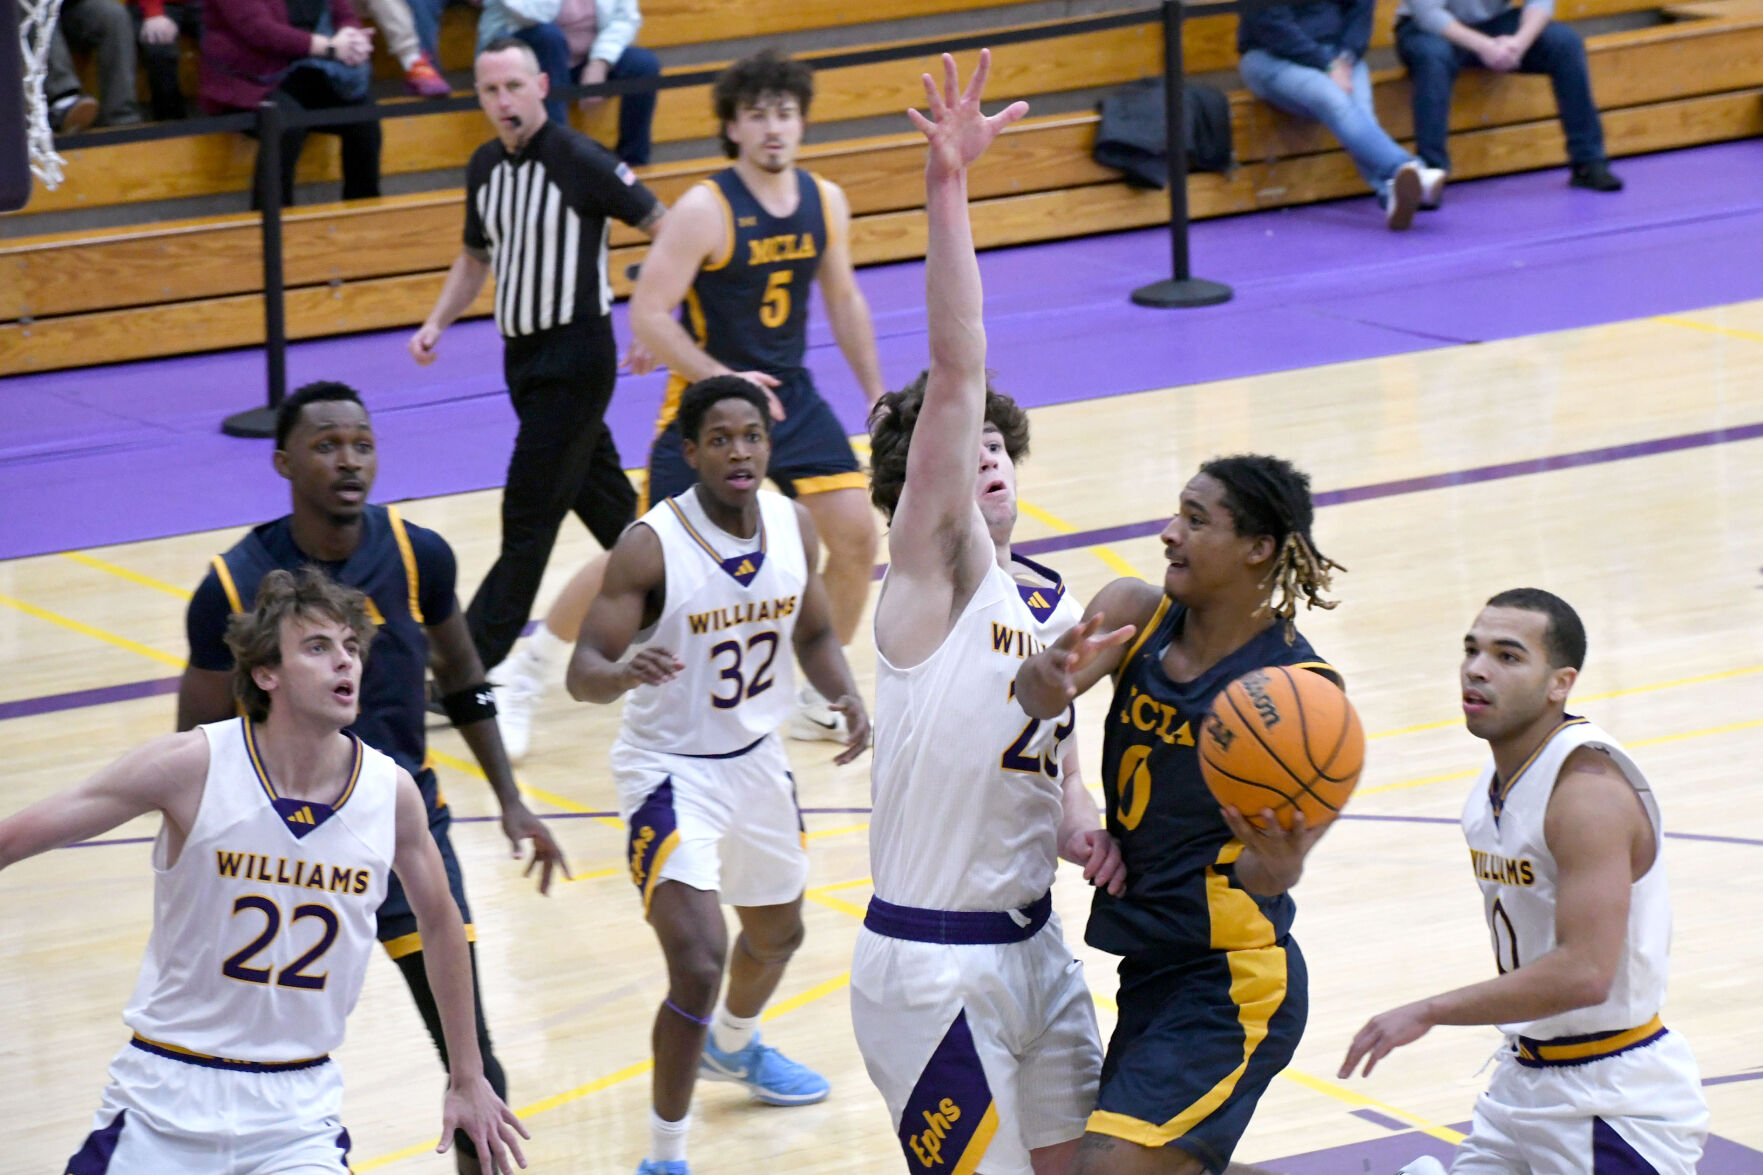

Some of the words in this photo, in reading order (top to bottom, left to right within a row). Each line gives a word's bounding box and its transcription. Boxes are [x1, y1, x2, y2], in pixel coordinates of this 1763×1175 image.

[748, 233, 817, 265] MCLA
[759, 270, 793, 328] 5
[688, 595, 797, 635] WILLIAMS
[711, 630, 779, 709] 32
[1116, 744, 1152, 831] 0
[216, 849, 370, 895] WILLIAMS
[222, 893, 340, 992] 22
[1492, 897, 1520, 975] 0
[909, 1098, 961, 1168] Ephs
